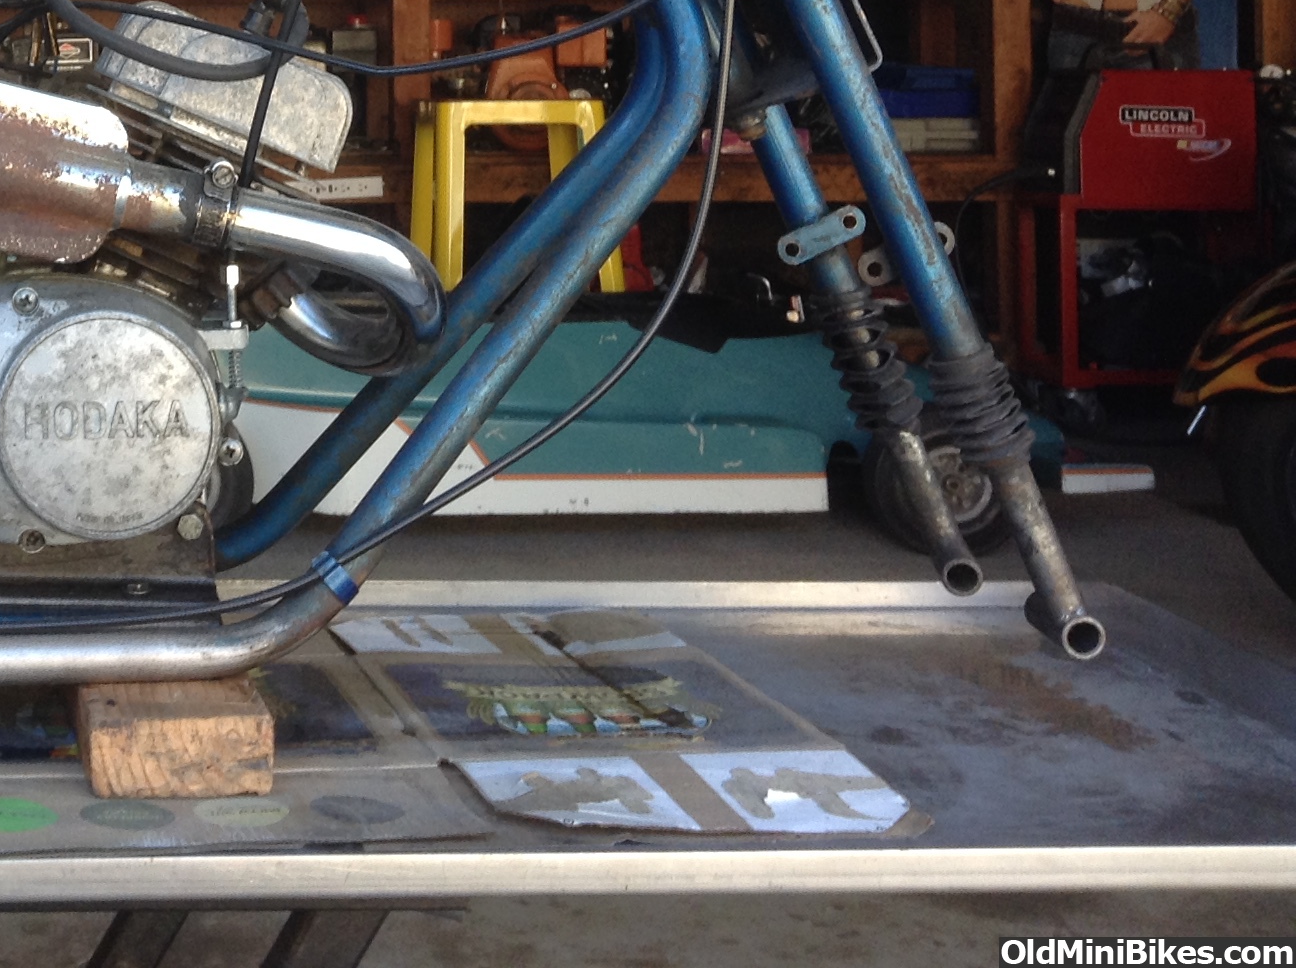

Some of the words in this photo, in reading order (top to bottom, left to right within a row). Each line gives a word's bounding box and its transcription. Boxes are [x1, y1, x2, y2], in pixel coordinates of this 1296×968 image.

[1124, 109, 1189, 122] LINCOLN
[1140, 123, 1198, 135] ELECTRIC
[23, 399, 190, 441] HODAKA
